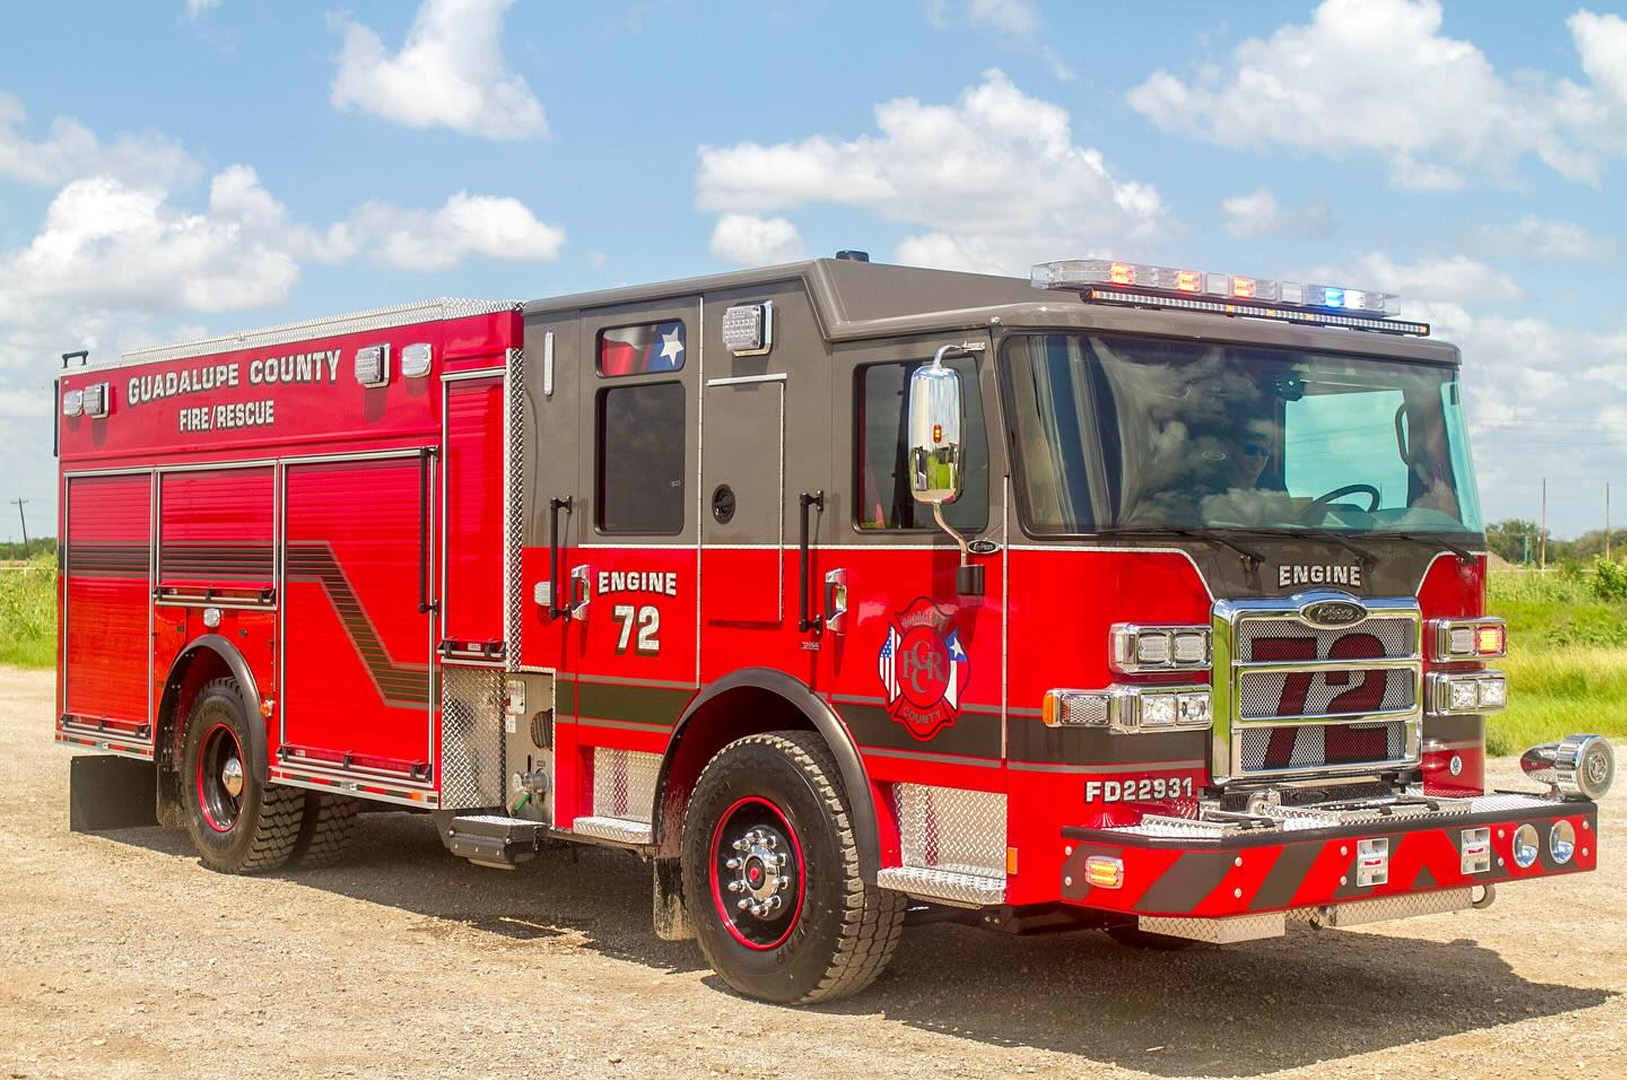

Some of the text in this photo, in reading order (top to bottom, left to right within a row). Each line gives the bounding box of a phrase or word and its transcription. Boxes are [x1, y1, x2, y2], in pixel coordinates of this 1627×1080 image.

[127, 349, 342, 406] GUADALUPE COUNTY
[179, 400, 275, 432] FIRE/RESCUE
[598, 571, 677, 597] ENGINE
[1278, 565, 1362, 588] ENGINE
[612, 604, 661, 654] 72
[1251, 632, 1389, 769] 72
[1085, 777, 1193, 803] FD22931
